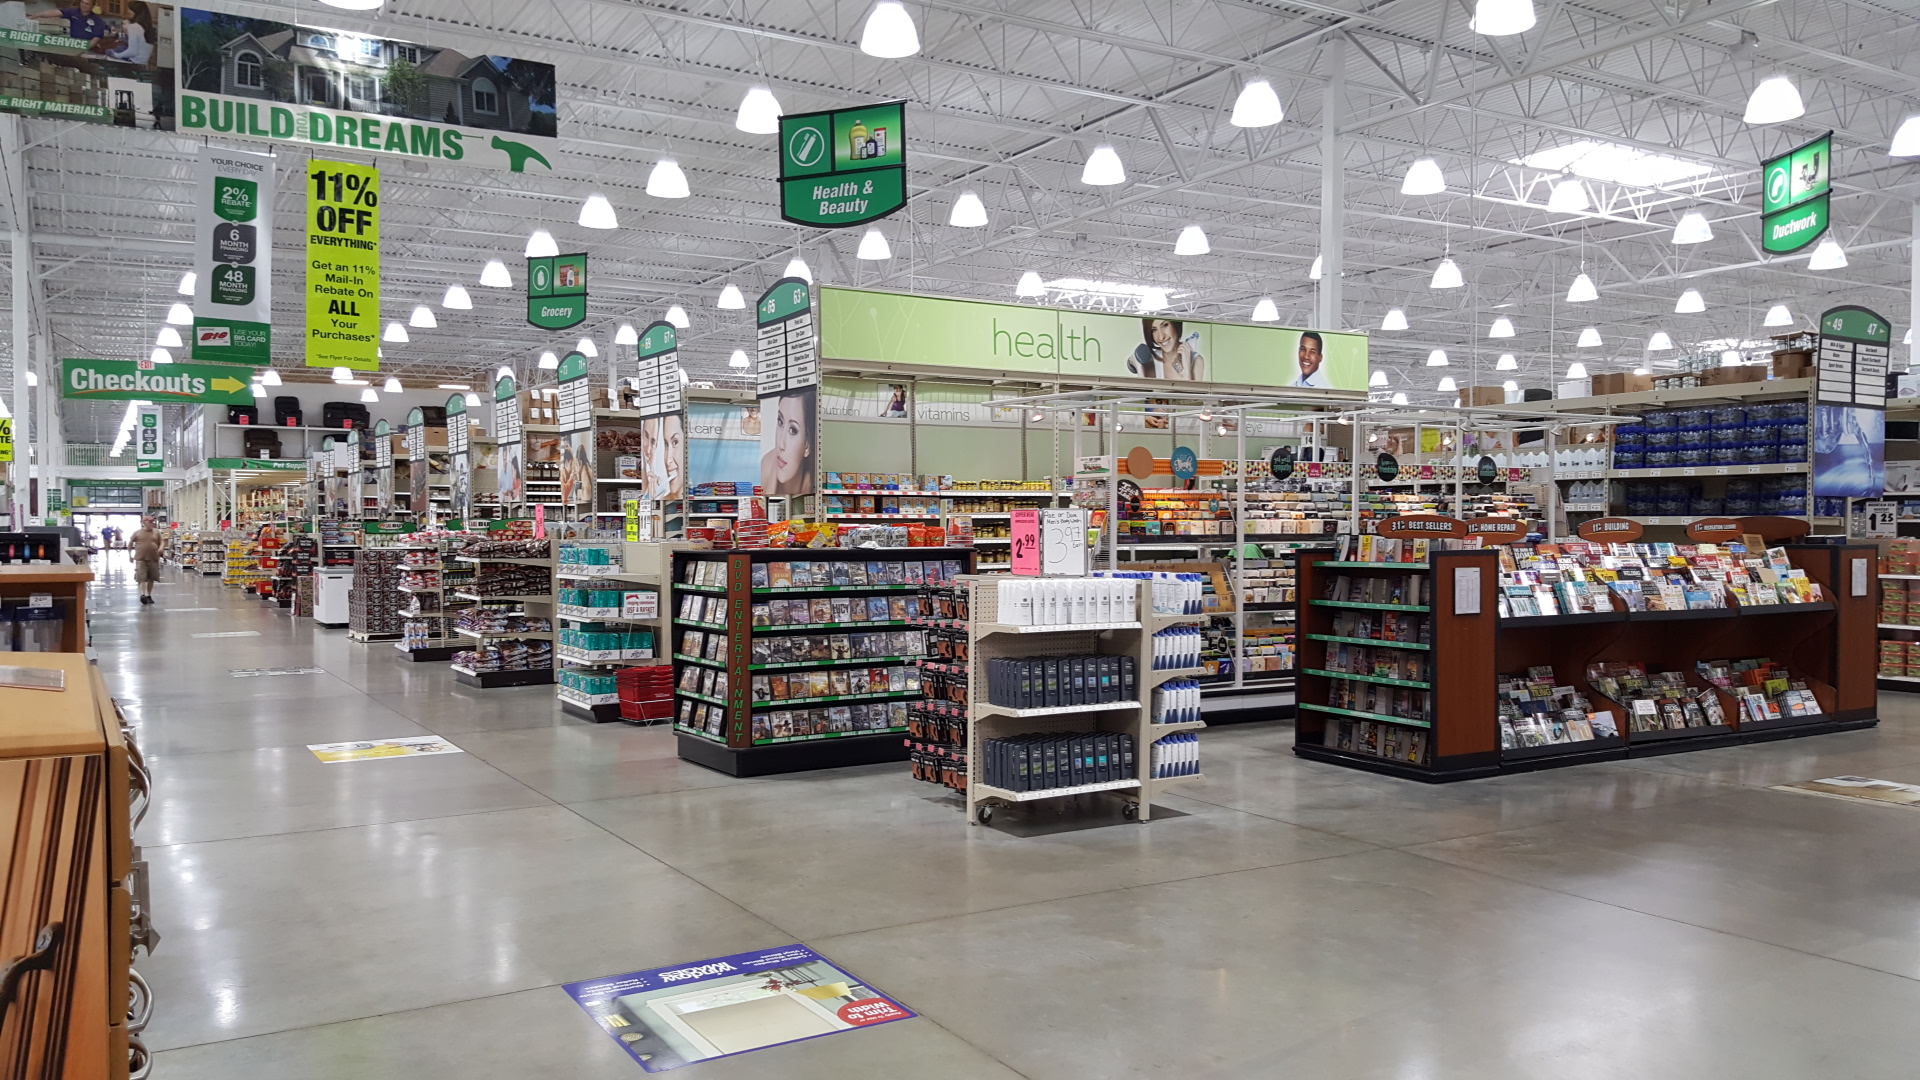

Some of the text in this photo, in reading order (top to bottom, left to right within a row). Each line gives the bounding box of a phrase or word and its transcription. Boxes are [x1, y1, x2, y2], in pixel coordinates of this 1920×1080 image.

[10, 31, 88, 50] RIGHT SERVICE
[11, 98, 104, 116] RIGHT MATERIALS
[182, 95, 464, 160] BUILD YOUR DREAMS
[211, 158, 264, 171] YOUR CHOICE
[218, 166, 240, 174] EVERY
[222, 187, 249, 202] 2%
[311, 170, 378, 208] 11%
[812, 180, 874, 200] Health &
[819, 198, 868, 216] Beauty
[317, 206, 372, 236] OFF
[1773, 212, 1817, 240] Ductwork
[230, 229, 240, 240] 6
[220, 240, 249, 248] MONTH
[312, 260, 332, 270] Get
[352, 265, 376, 275] 11%
[224, 270, 243, 282] 48
[326, 274, 364, 286] Mail-In
[220, 281, 248, 289] MONTH
[315, 285, 374, 298] Rebate On
[328, 300, 360, 316] ALL
[767, 289, 801, 314] 65 63
[542, 306, 572, 318] Grocery
[331, 319, 358, 328] Your
[1832, 318, 1878, 335] 49 47
[992, 318, 1101, 362] health
[71, 368, 206, 394] Checkouts
[917, 408, 970, 422] vitamins
[695, 424, 722, 435] care
[1408, 521, 1424, 530] BEST
[1425, 521, 1452, 531] SELLERS
[1604, 522, 1629, 531] BUILDING
[734, 560, 743, 592] DVD
[734, 599, 744, 742] ENTERTAINMENT
[847, 1002, 890, 1013] Width
[864, 1007, 897, 1017] Trim
